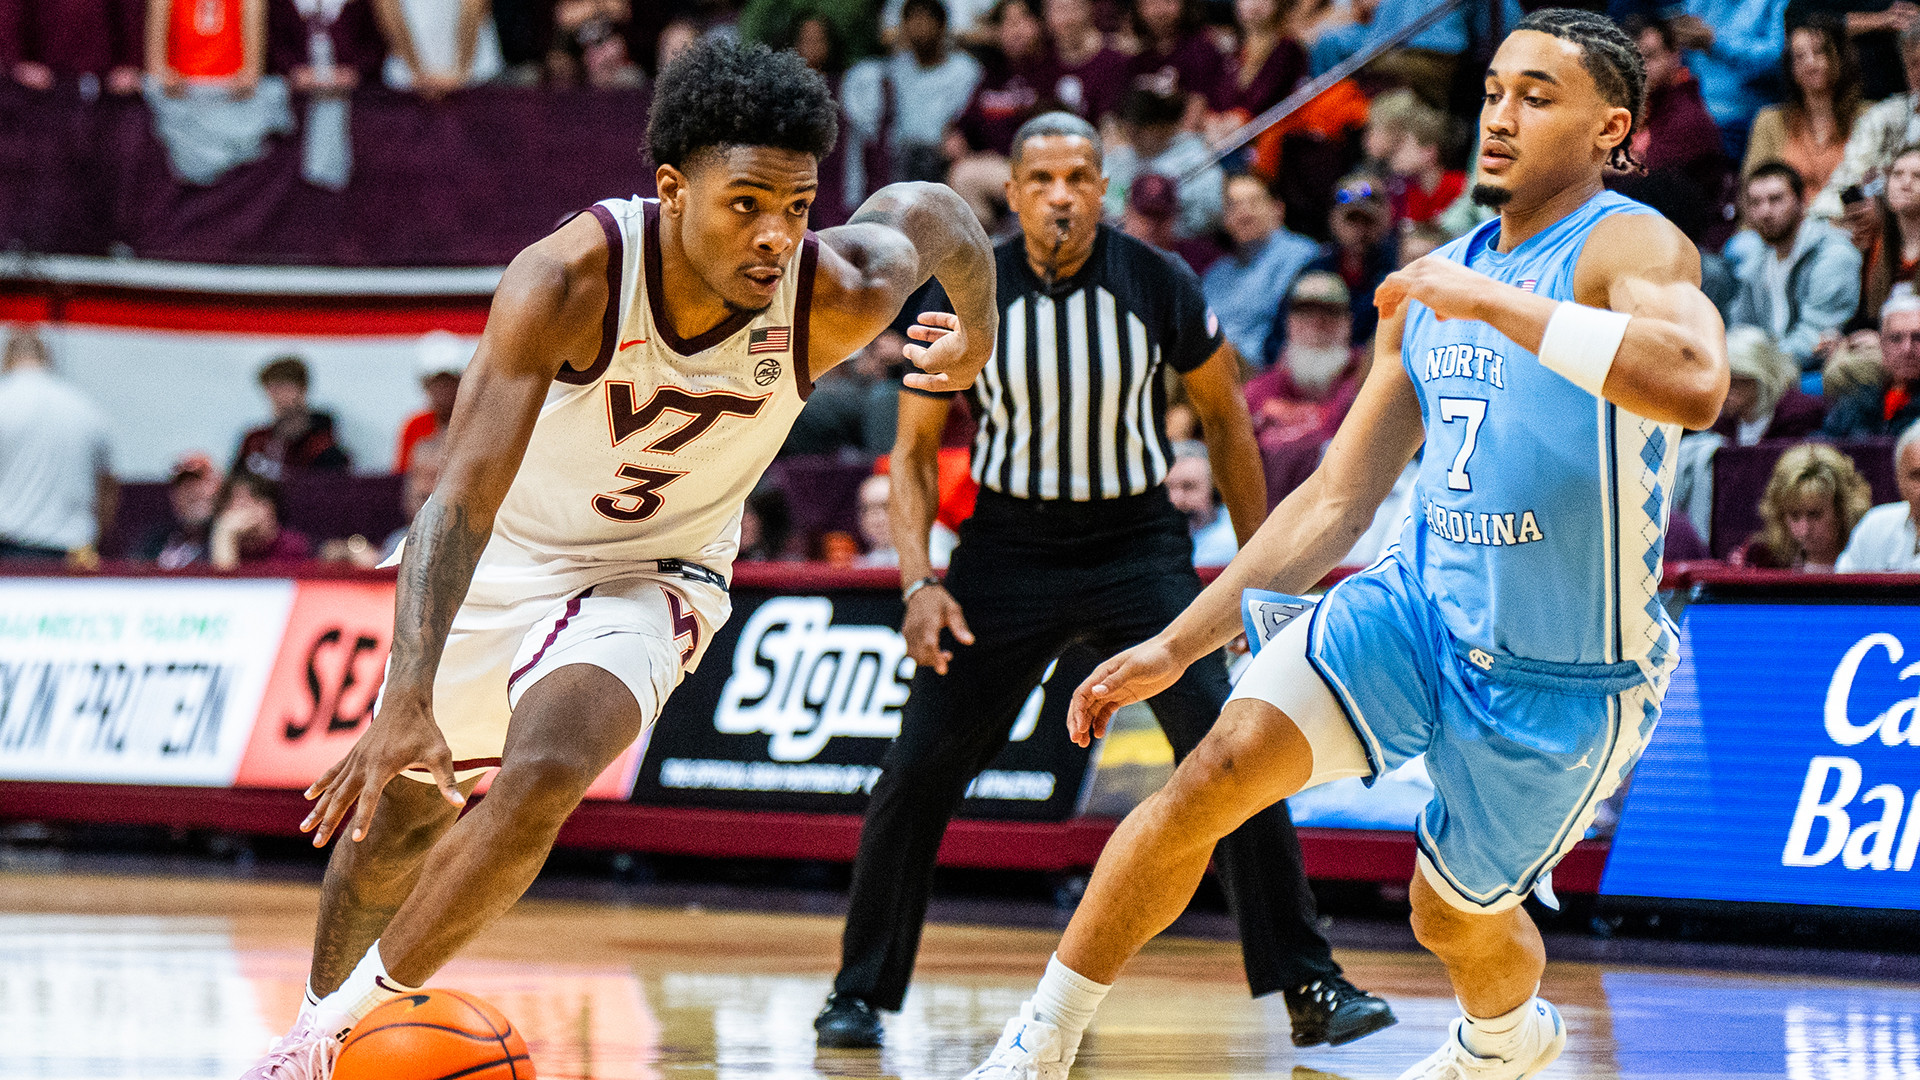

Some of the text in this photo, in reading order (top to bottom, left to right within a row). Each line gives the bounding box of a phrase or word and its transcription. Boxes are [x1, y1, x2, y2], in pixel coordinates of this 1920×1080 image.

[758, 366, 781, 377] ACC
[1424, 343, 1505, 390] NORTH
[605, 380, 774, 456] VT
[1438, 396, 1490, 493] 7
[591, 462, 692, 524] 3
[284, 628, 375, 741] SE
